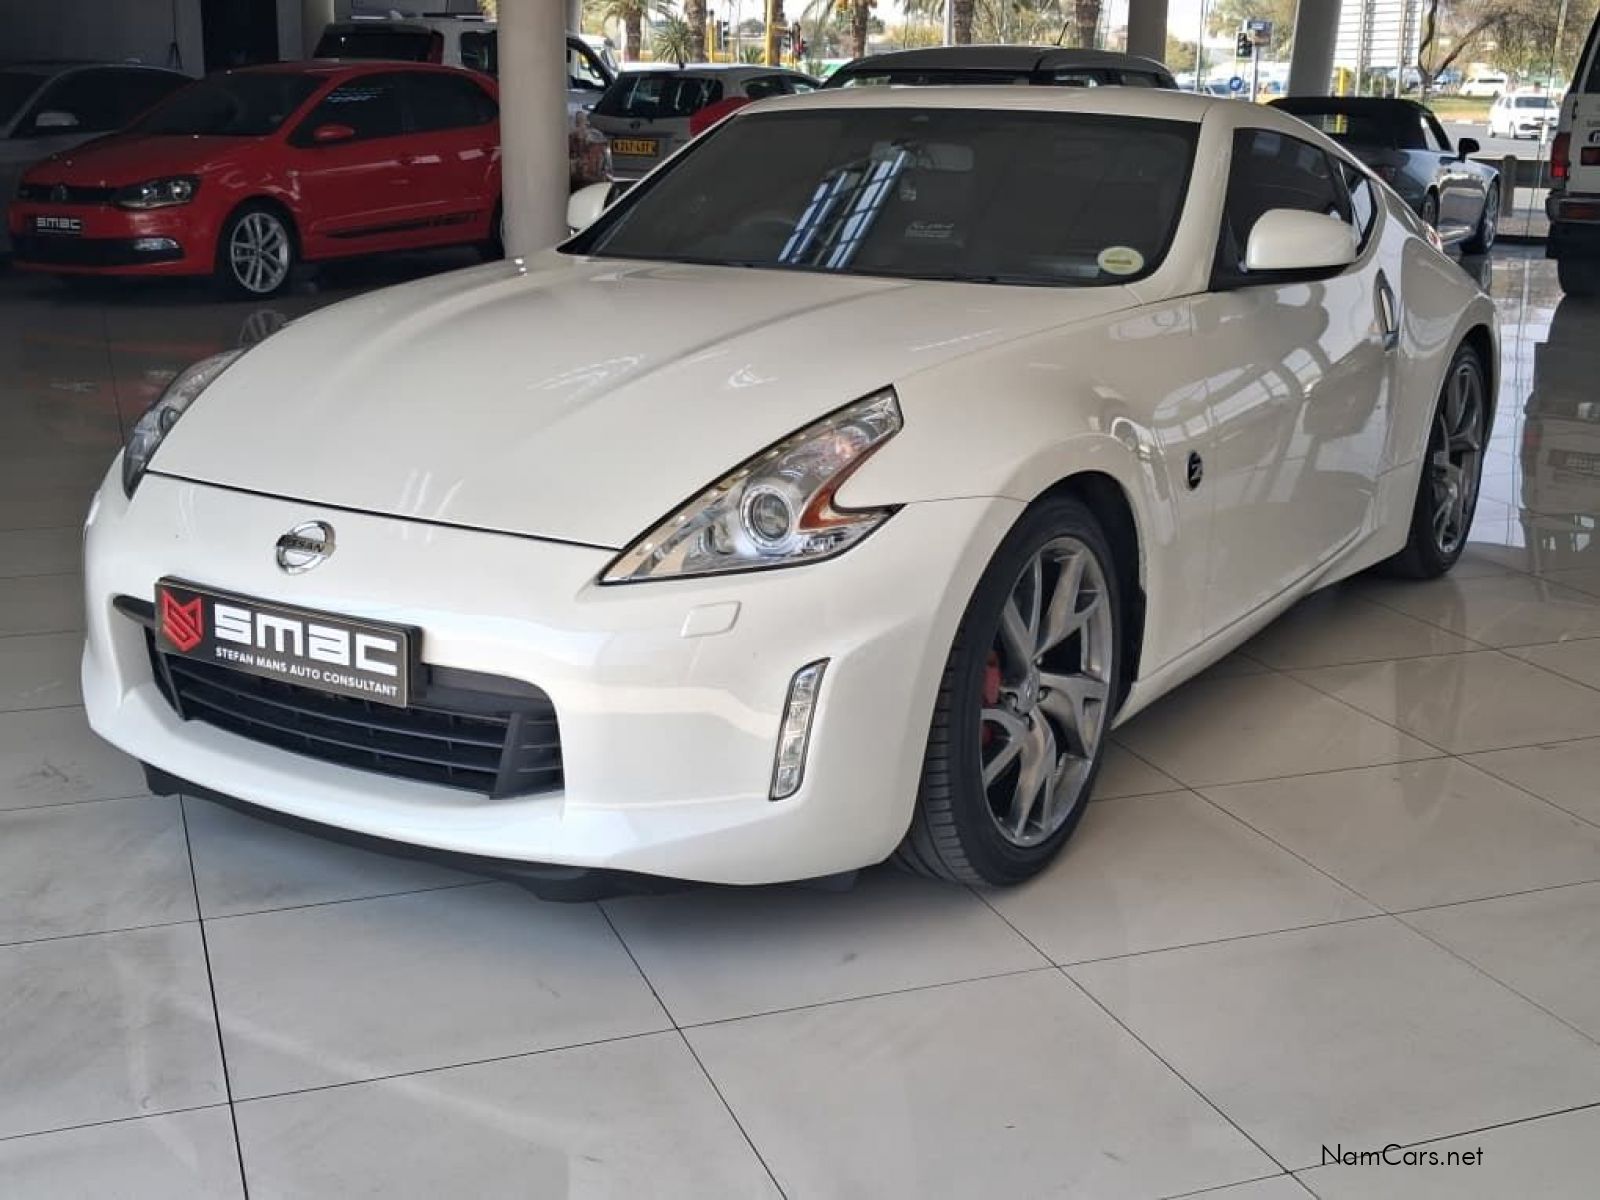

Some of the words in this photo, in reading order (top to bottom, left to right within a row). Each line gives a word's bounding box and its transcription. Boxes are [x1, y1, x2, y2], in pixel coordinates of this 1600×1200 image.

[215, 646, 254, 665] STEFAN
[256, 657, 288, 673] MANS
[290, 667, 321, 681] AUTO
[322, 673, 398, 697] CONSULTANT
